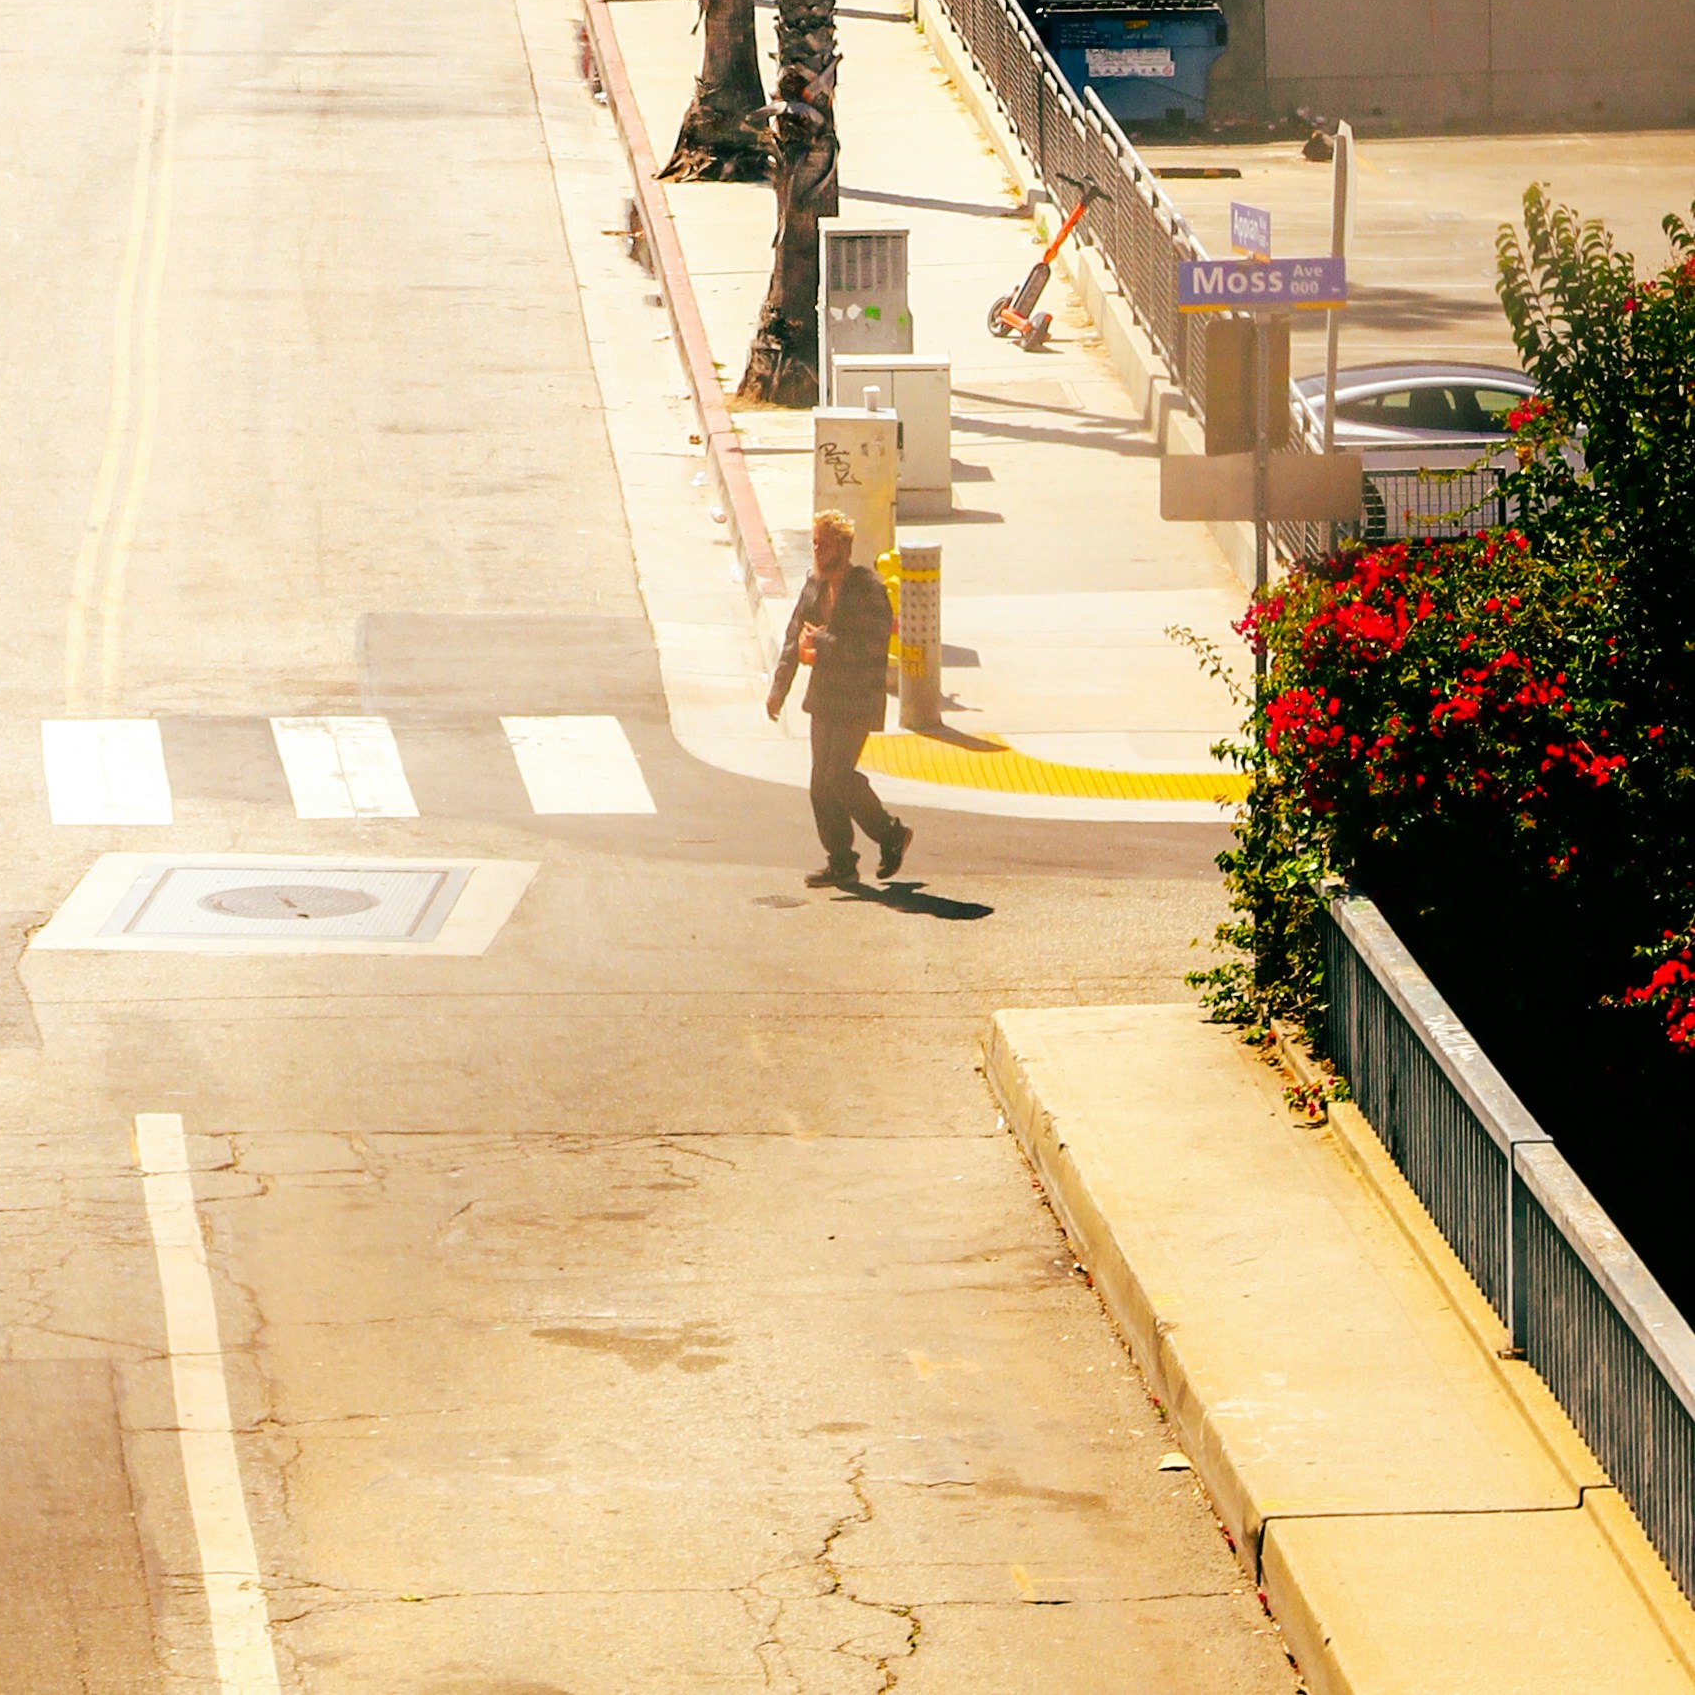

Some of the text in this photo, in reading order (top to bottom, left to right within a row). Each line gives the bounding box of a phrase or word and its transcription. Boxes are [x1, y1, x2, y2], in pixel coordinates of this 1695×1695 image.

[1233, 209, 1258, 245] Appian
[1192, 263, 1323, 295] Moss Ave
[1290, 280, 1319, 295] 000
